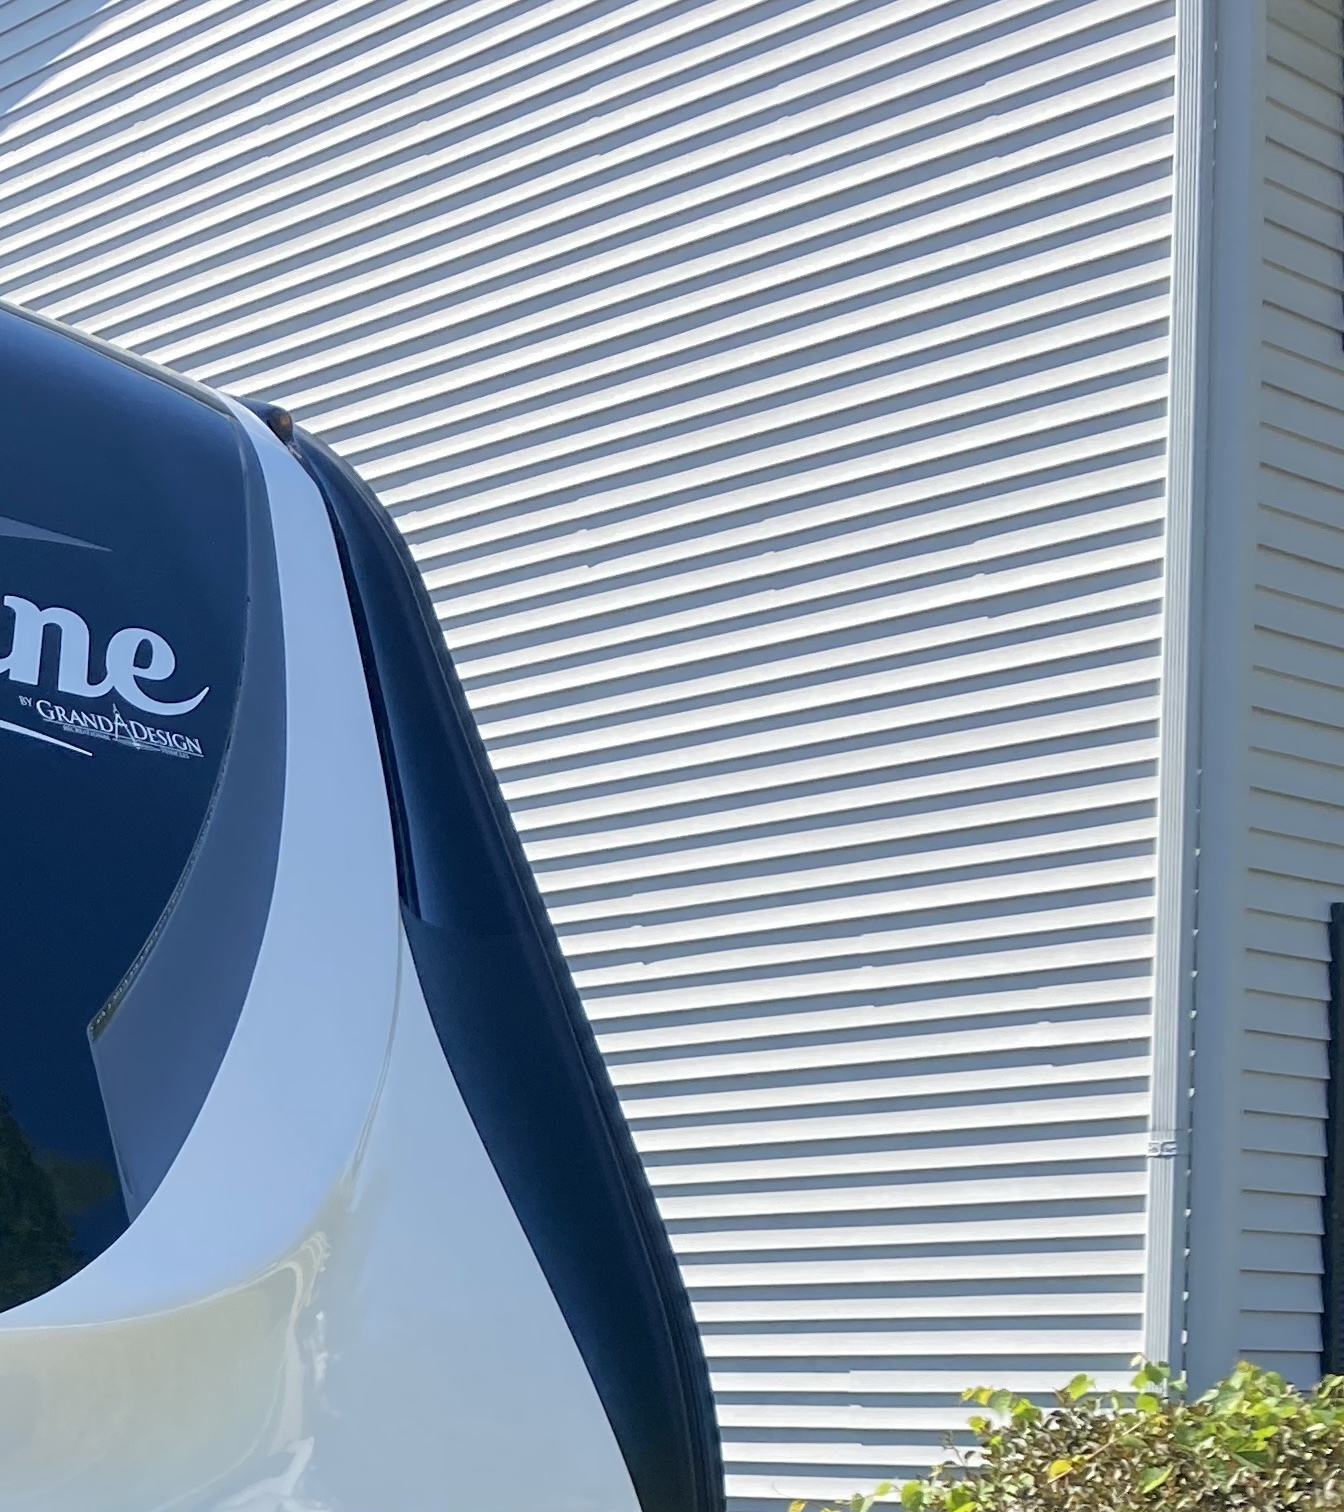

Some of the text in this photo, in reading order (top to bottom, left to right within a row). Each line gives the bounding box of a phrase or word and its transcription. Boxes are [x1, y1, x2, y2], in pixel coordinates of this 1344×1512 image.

[18, 695, 203, 754] BY GRAND DESIGN
